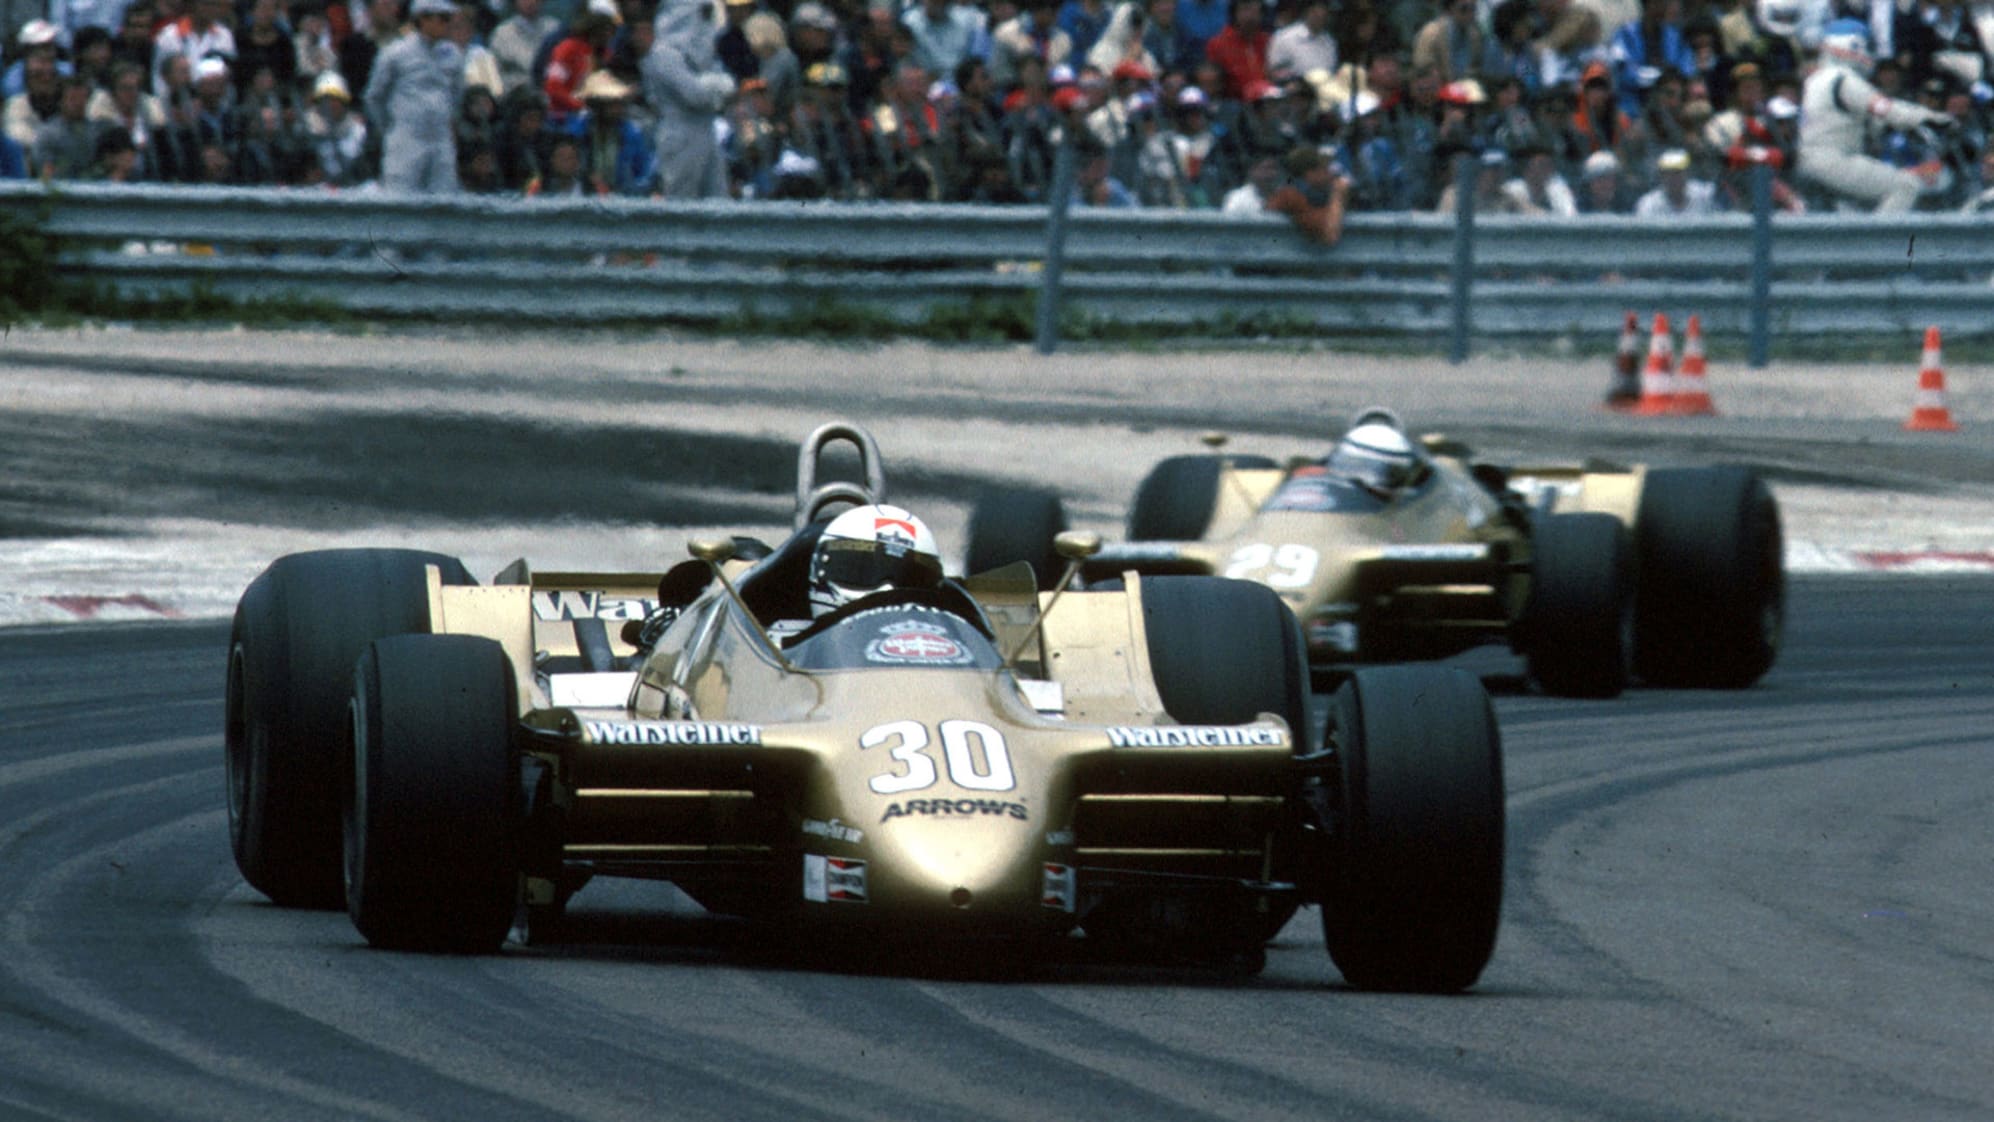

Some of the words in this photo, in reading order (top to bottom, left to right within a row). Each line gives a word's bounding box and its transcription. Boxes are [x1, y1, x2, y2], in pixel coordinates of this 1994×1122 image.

[1224, 543, 1319, 587] 29
[587, 720, 763, 745] Warsteiner
[860, 718, 1016, 794] 30
[880, 799, 1028, 823] ARROWS
